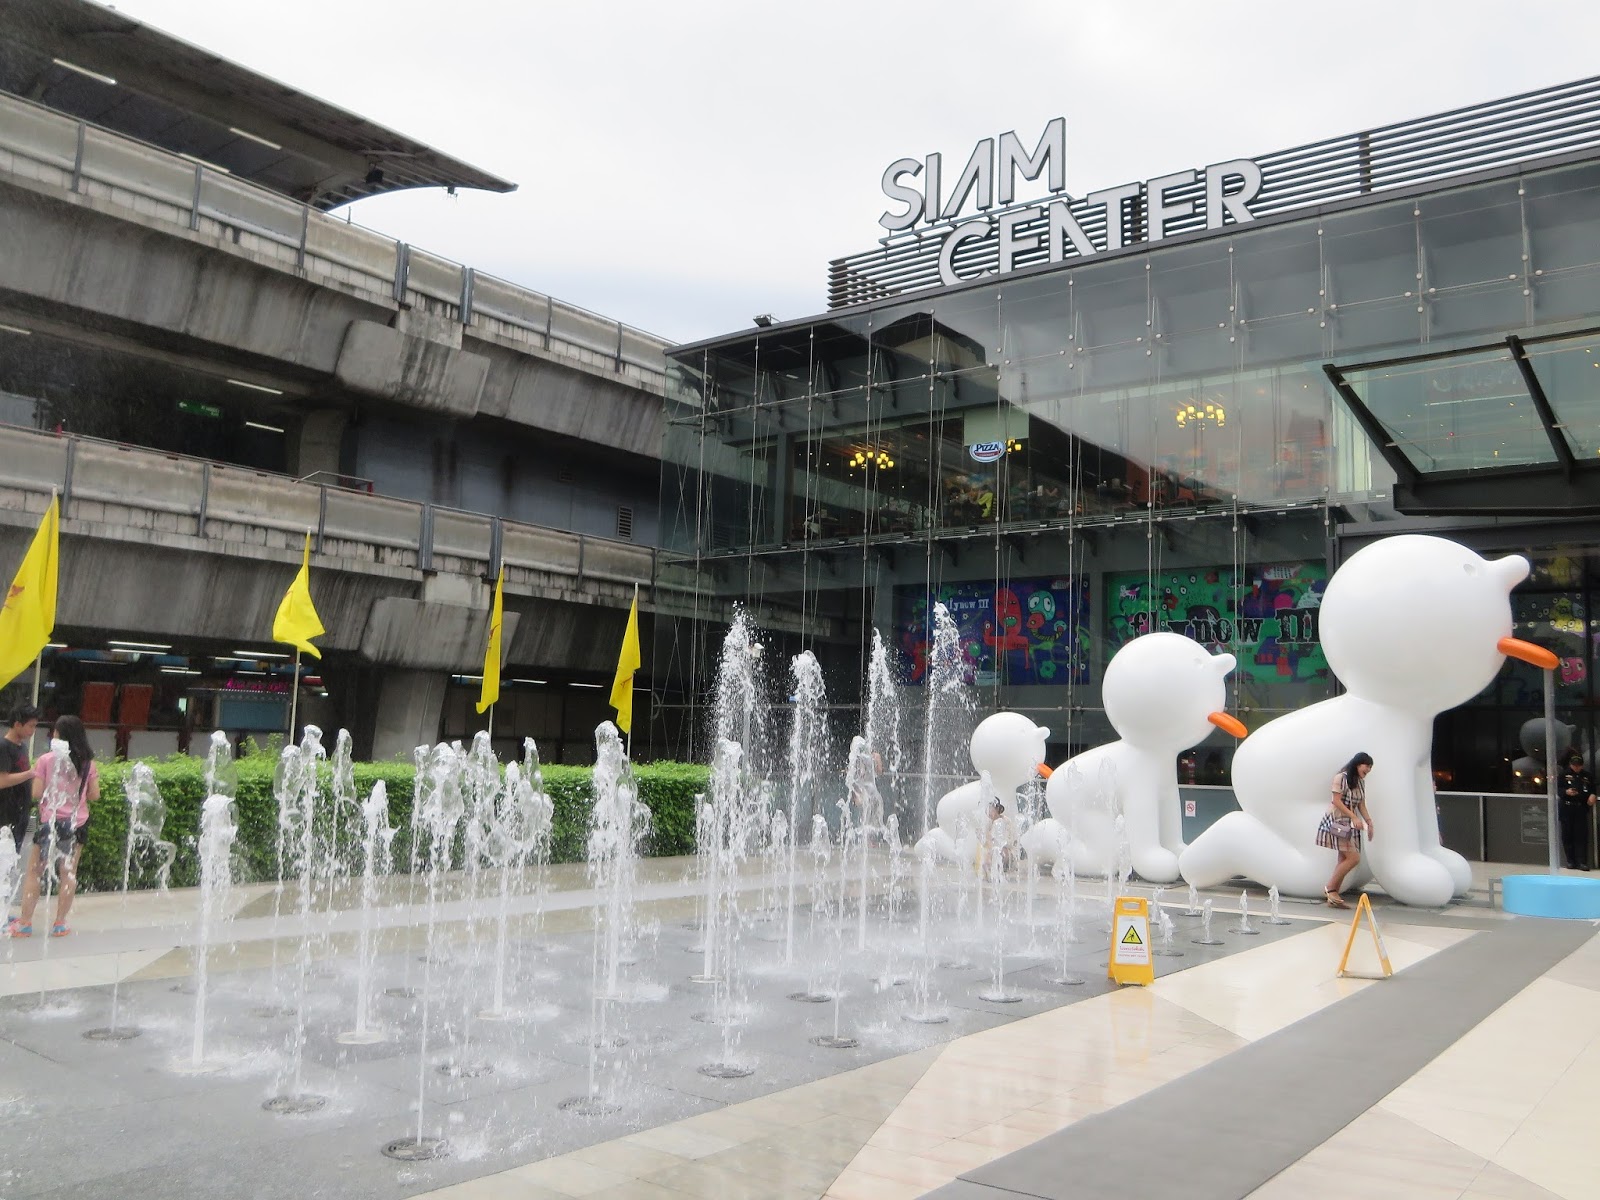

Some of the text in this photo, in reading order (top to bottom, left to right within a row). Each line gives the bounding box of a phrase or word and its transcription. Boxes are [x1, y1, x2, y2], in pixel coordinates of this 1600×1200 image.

[878, 117, 1066, 231] SIAM
[938, 158, 1263, 287] CENTER
[975, 443, 999, 451] PIZZA
